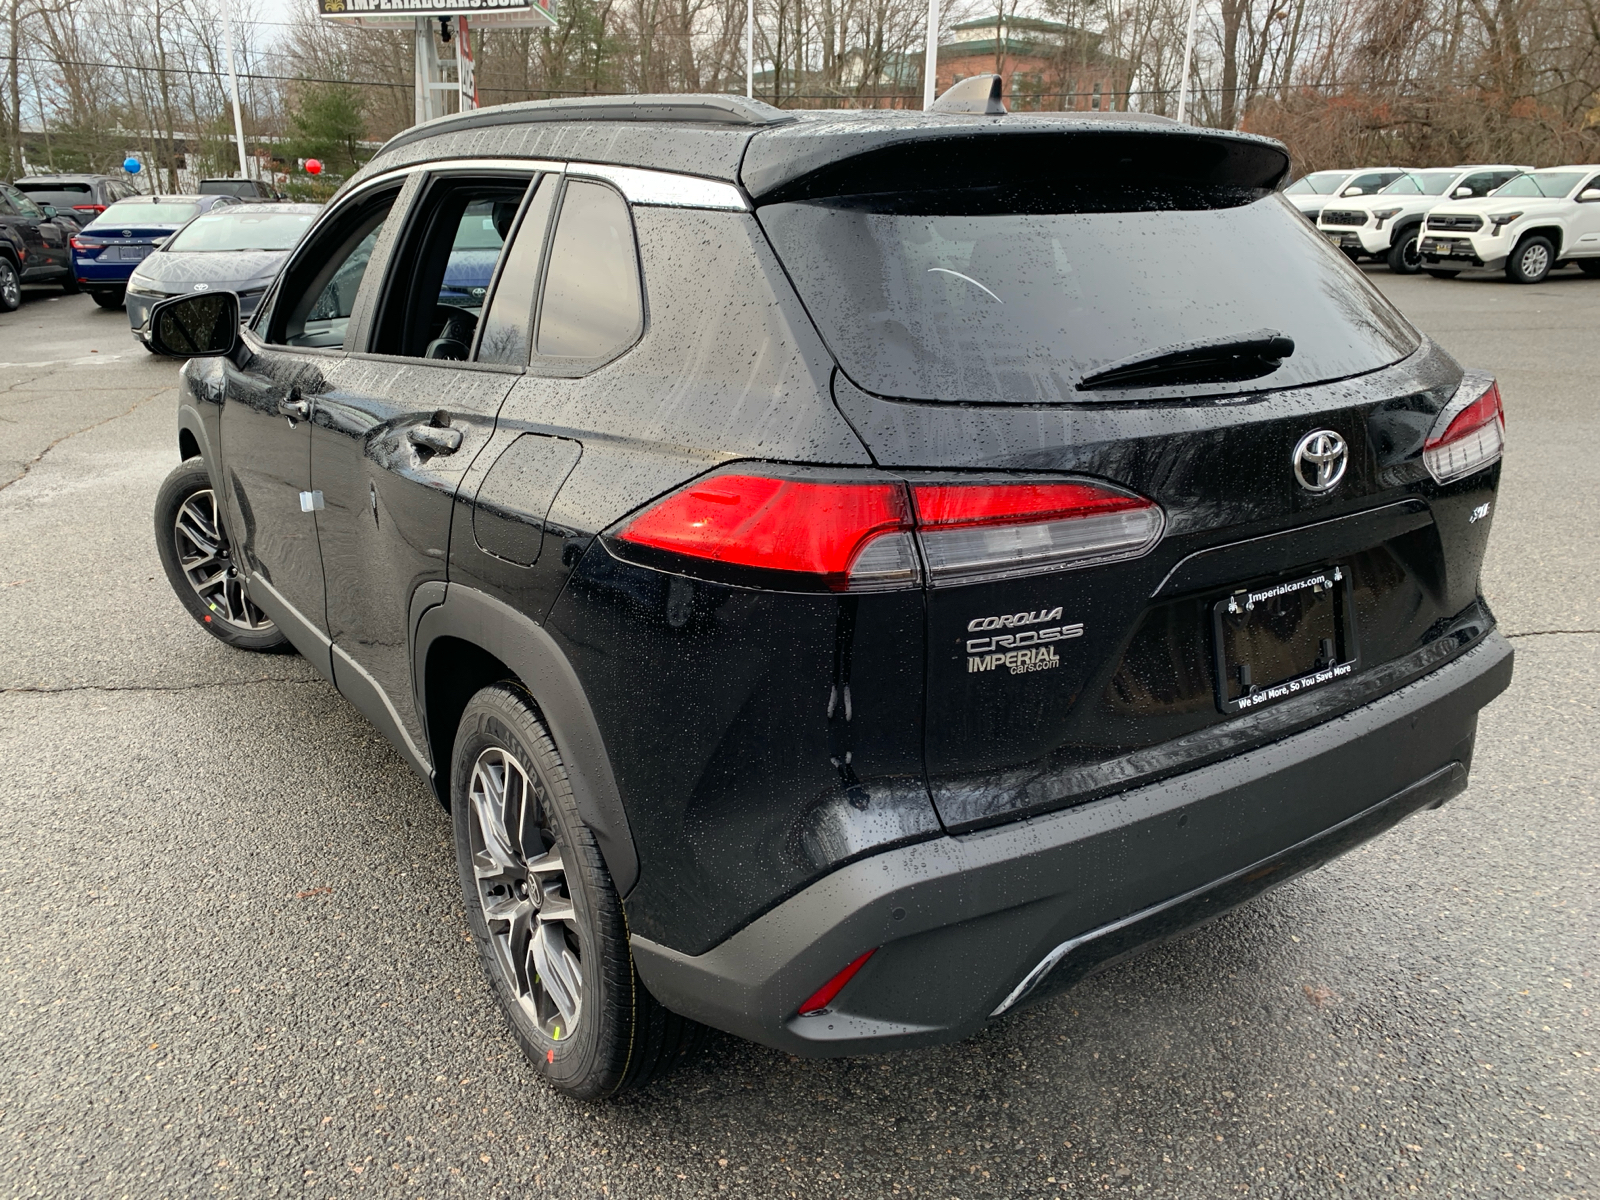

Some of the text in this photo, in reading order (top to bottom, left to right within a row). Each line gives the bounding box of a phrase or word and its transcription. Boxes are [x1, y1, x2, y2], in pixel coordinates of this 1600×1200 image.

[1248, 575, 1325, 603] Imperialcars.com
[967, 606, 1063, 632] COROLLA
[966, 622, 1084, 653] CROSS
[967, 644, 1060, 673] IMPERIAL
[1010, 659, 1059, 675] cars.com
[1239, 664, 1352, 709] We Sell More, So You Save More
[504, 731, 566, 848] ASSURANCE
